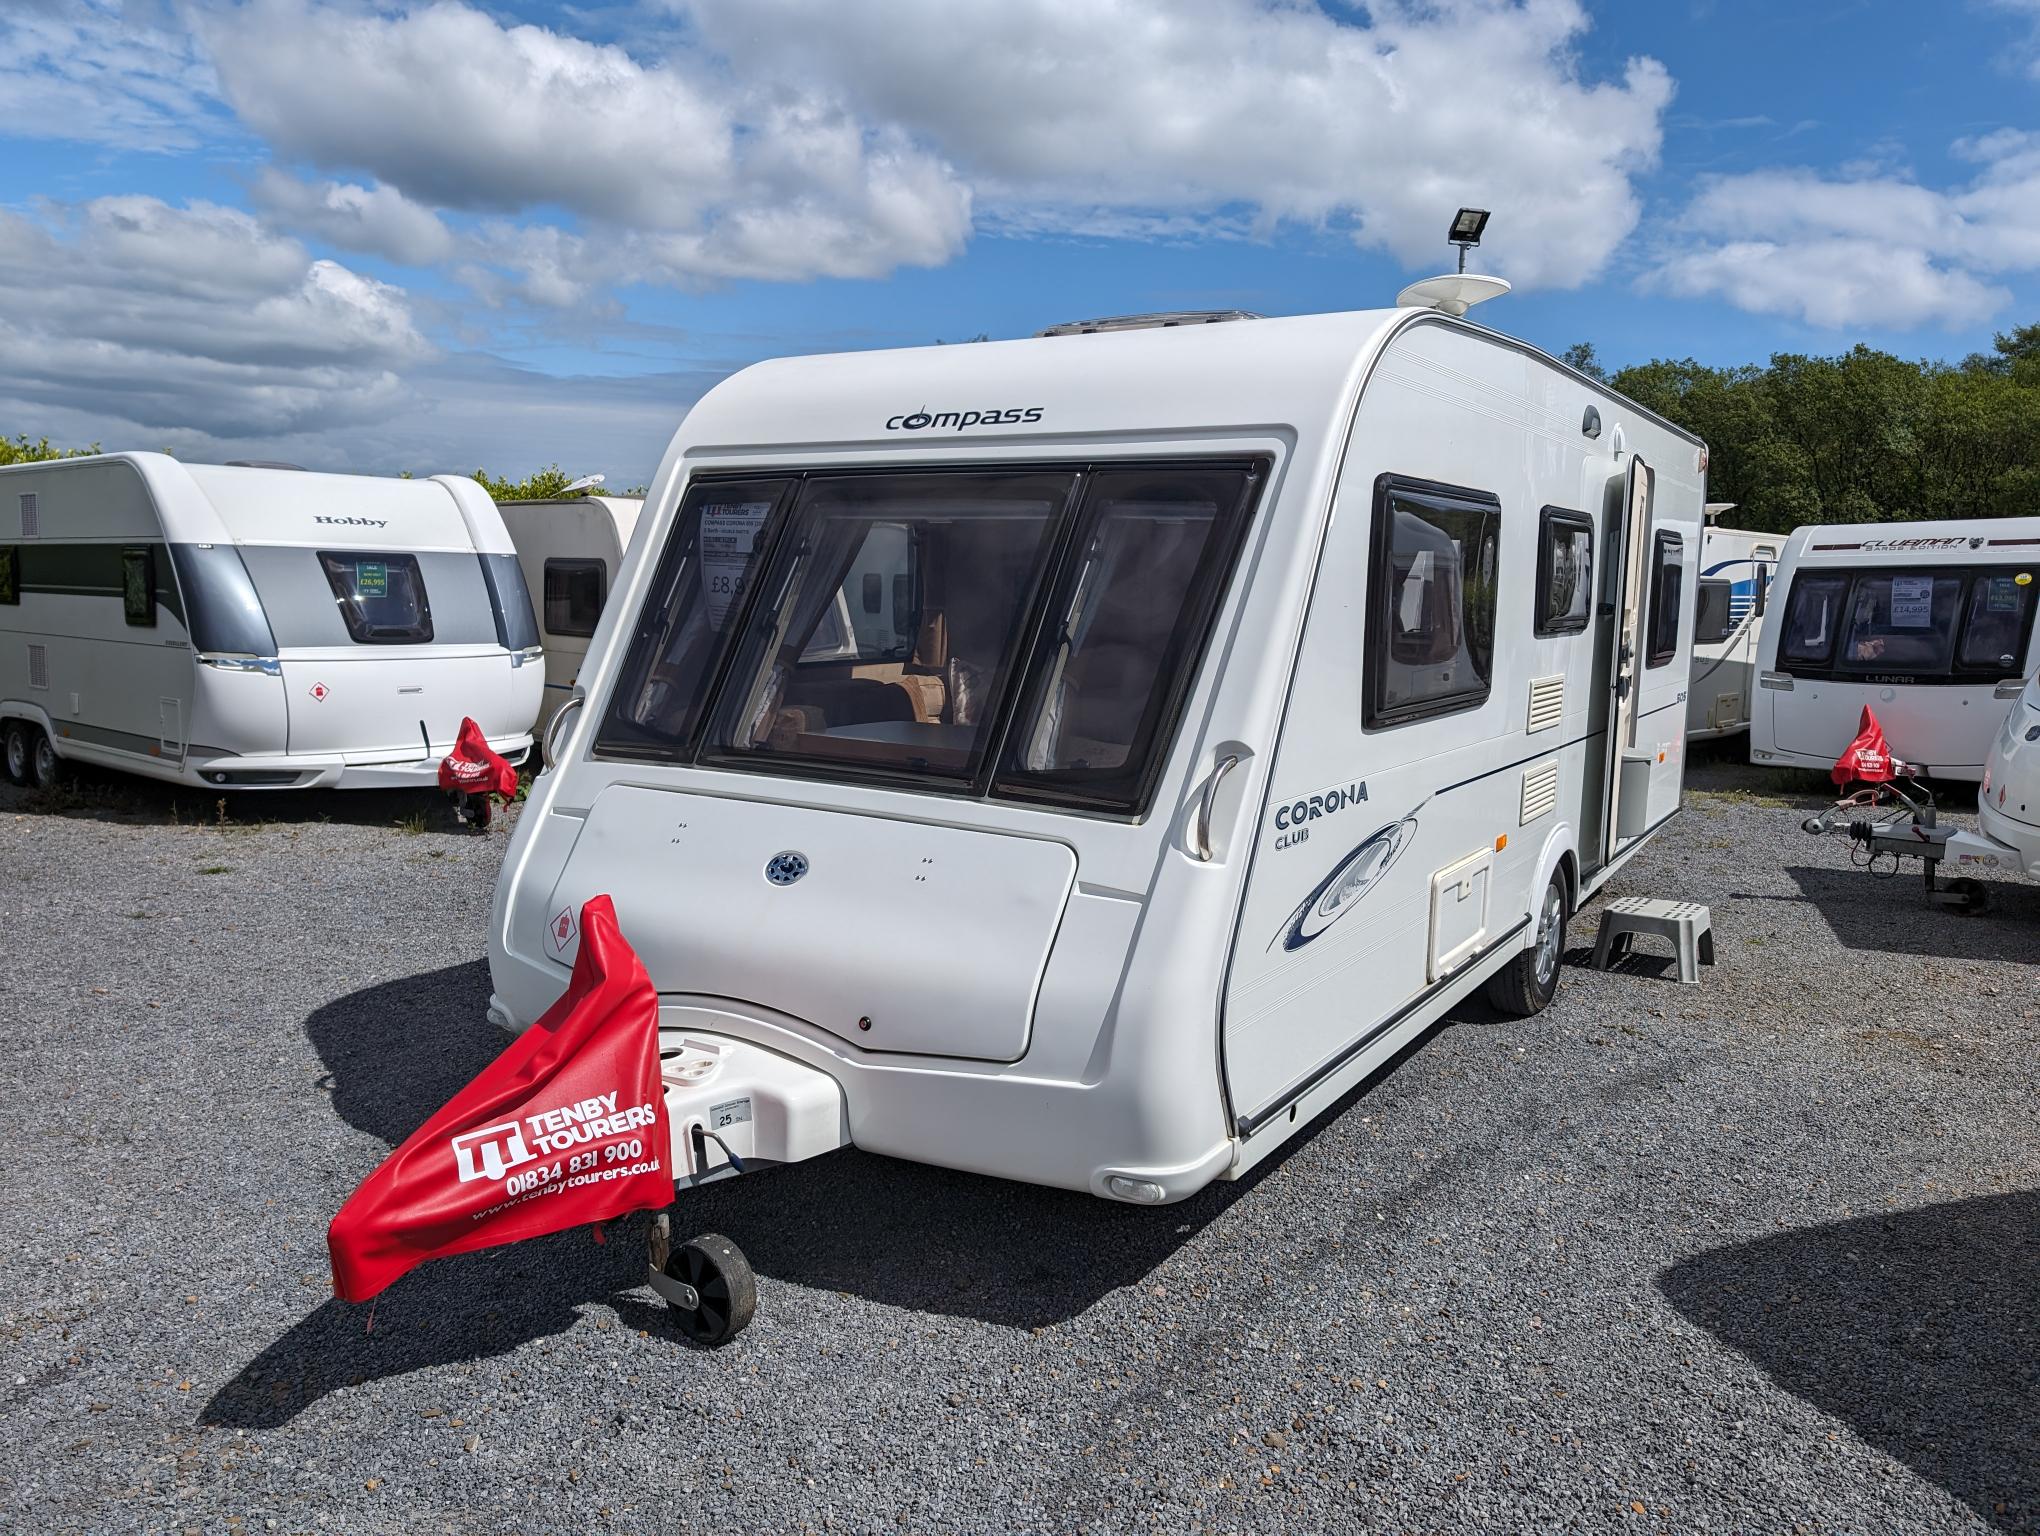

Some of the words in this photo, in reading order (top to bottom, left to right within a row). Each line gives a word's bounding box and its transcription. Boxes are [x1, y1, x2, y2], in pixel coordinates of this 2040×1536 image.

[886, 404, 1044, 431] compass
[313, 516, 388, 528] Hobby
[1861, 537, 1967, 547] CLUBMAN
[1866, 675, 1915, 683] LUNAR
[1275, 780, 1369, 830] CORONA
[1275, 828, 1309, 851] CLUB
[526, 1090, 617, 1136] TENBY
[719, 1113, 732, 1127] 25
[532, 1103, 656, 1155] TOURERS
[506, 1161, 562, 1196] 01834
[569, 1150, 598, 1174] 831
[604, 1139, 643, 1164] 900
[472, 1156, 660, 1221] www.tenbytourers.co.uk
